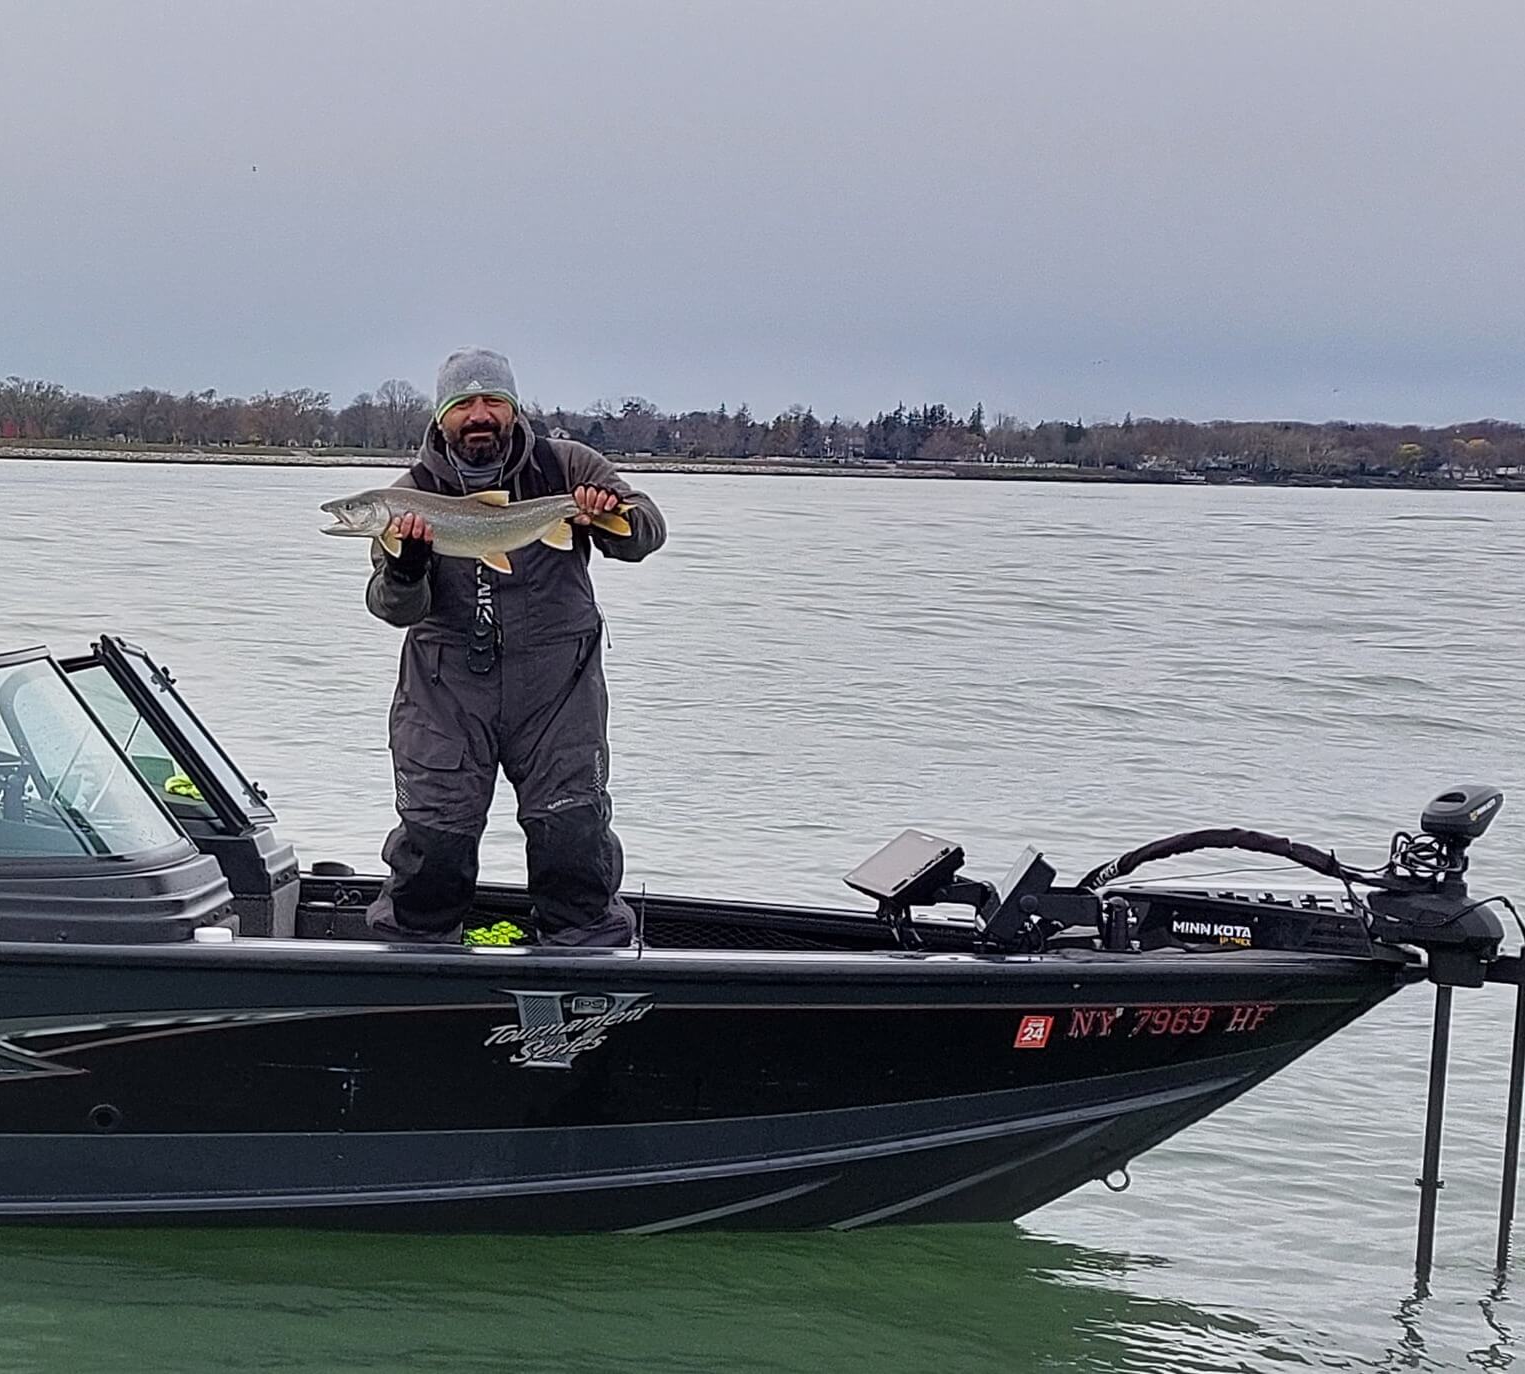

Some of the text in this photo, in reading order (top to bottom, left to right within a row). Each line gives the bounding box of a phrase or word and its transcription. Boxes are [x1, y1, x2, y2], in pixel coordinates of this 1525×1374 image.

[476, 561, 494, 625] SIM
[1172, 920, 1252, 938] MINN KOTA
[484, 1002, 655, 1047] Tournament
[1021, 1026, 1045, 1042] 24
[1067, 1006, 1274, 1038] NY 7969 HF
[509, 1034, 609, 1064] Series
